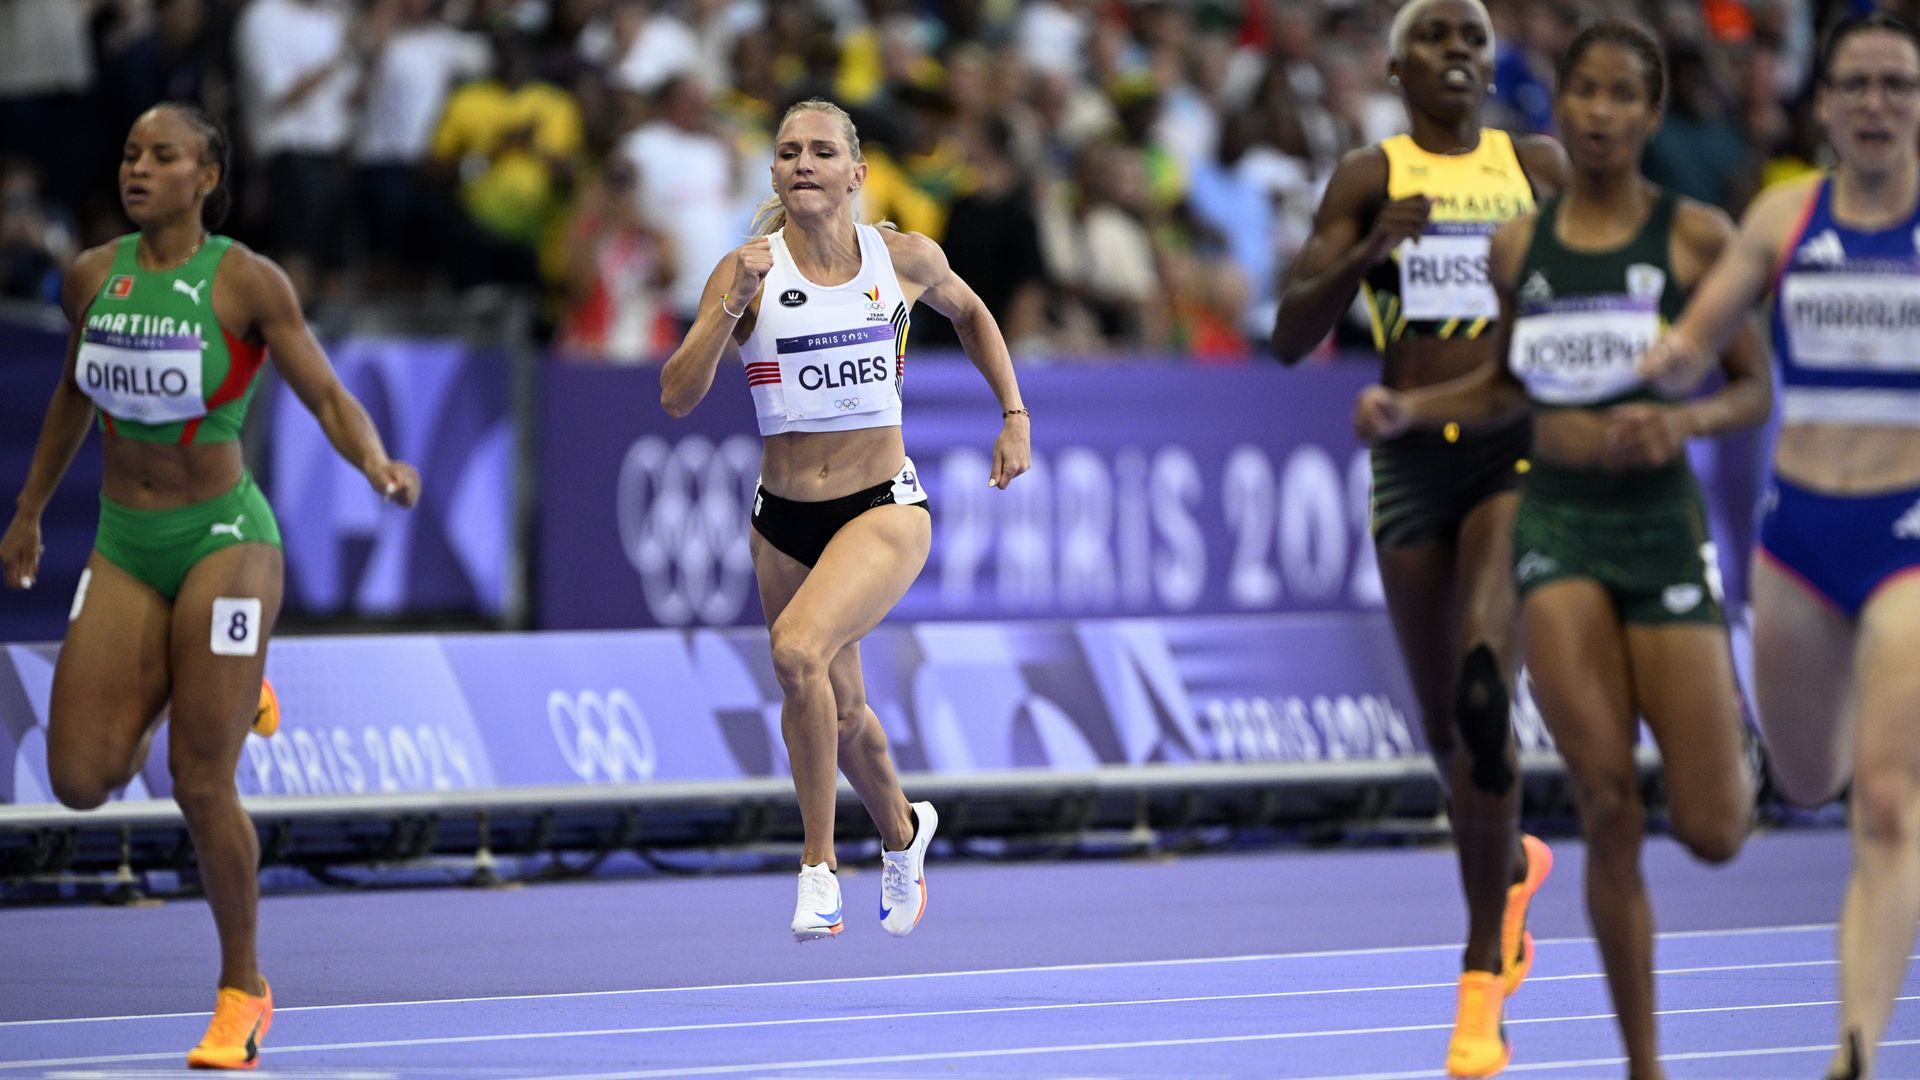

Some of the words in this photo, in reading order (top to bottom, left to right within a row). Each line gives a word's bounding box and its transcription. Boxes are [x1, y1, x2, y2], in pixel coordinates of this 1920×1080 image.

[808, 335, 839, 347] PARIS
[841, 331, 869, 342] 2024
[87, 360, 188, 397] DIALLO
[798, 355, 888, 391] CLAES
[941, 444, 1208, 610] PARIS
[228, 611, 248, 643] 8
[245, 725, 366, 796] PARIS
[362, 723, 478, 791] 2024
